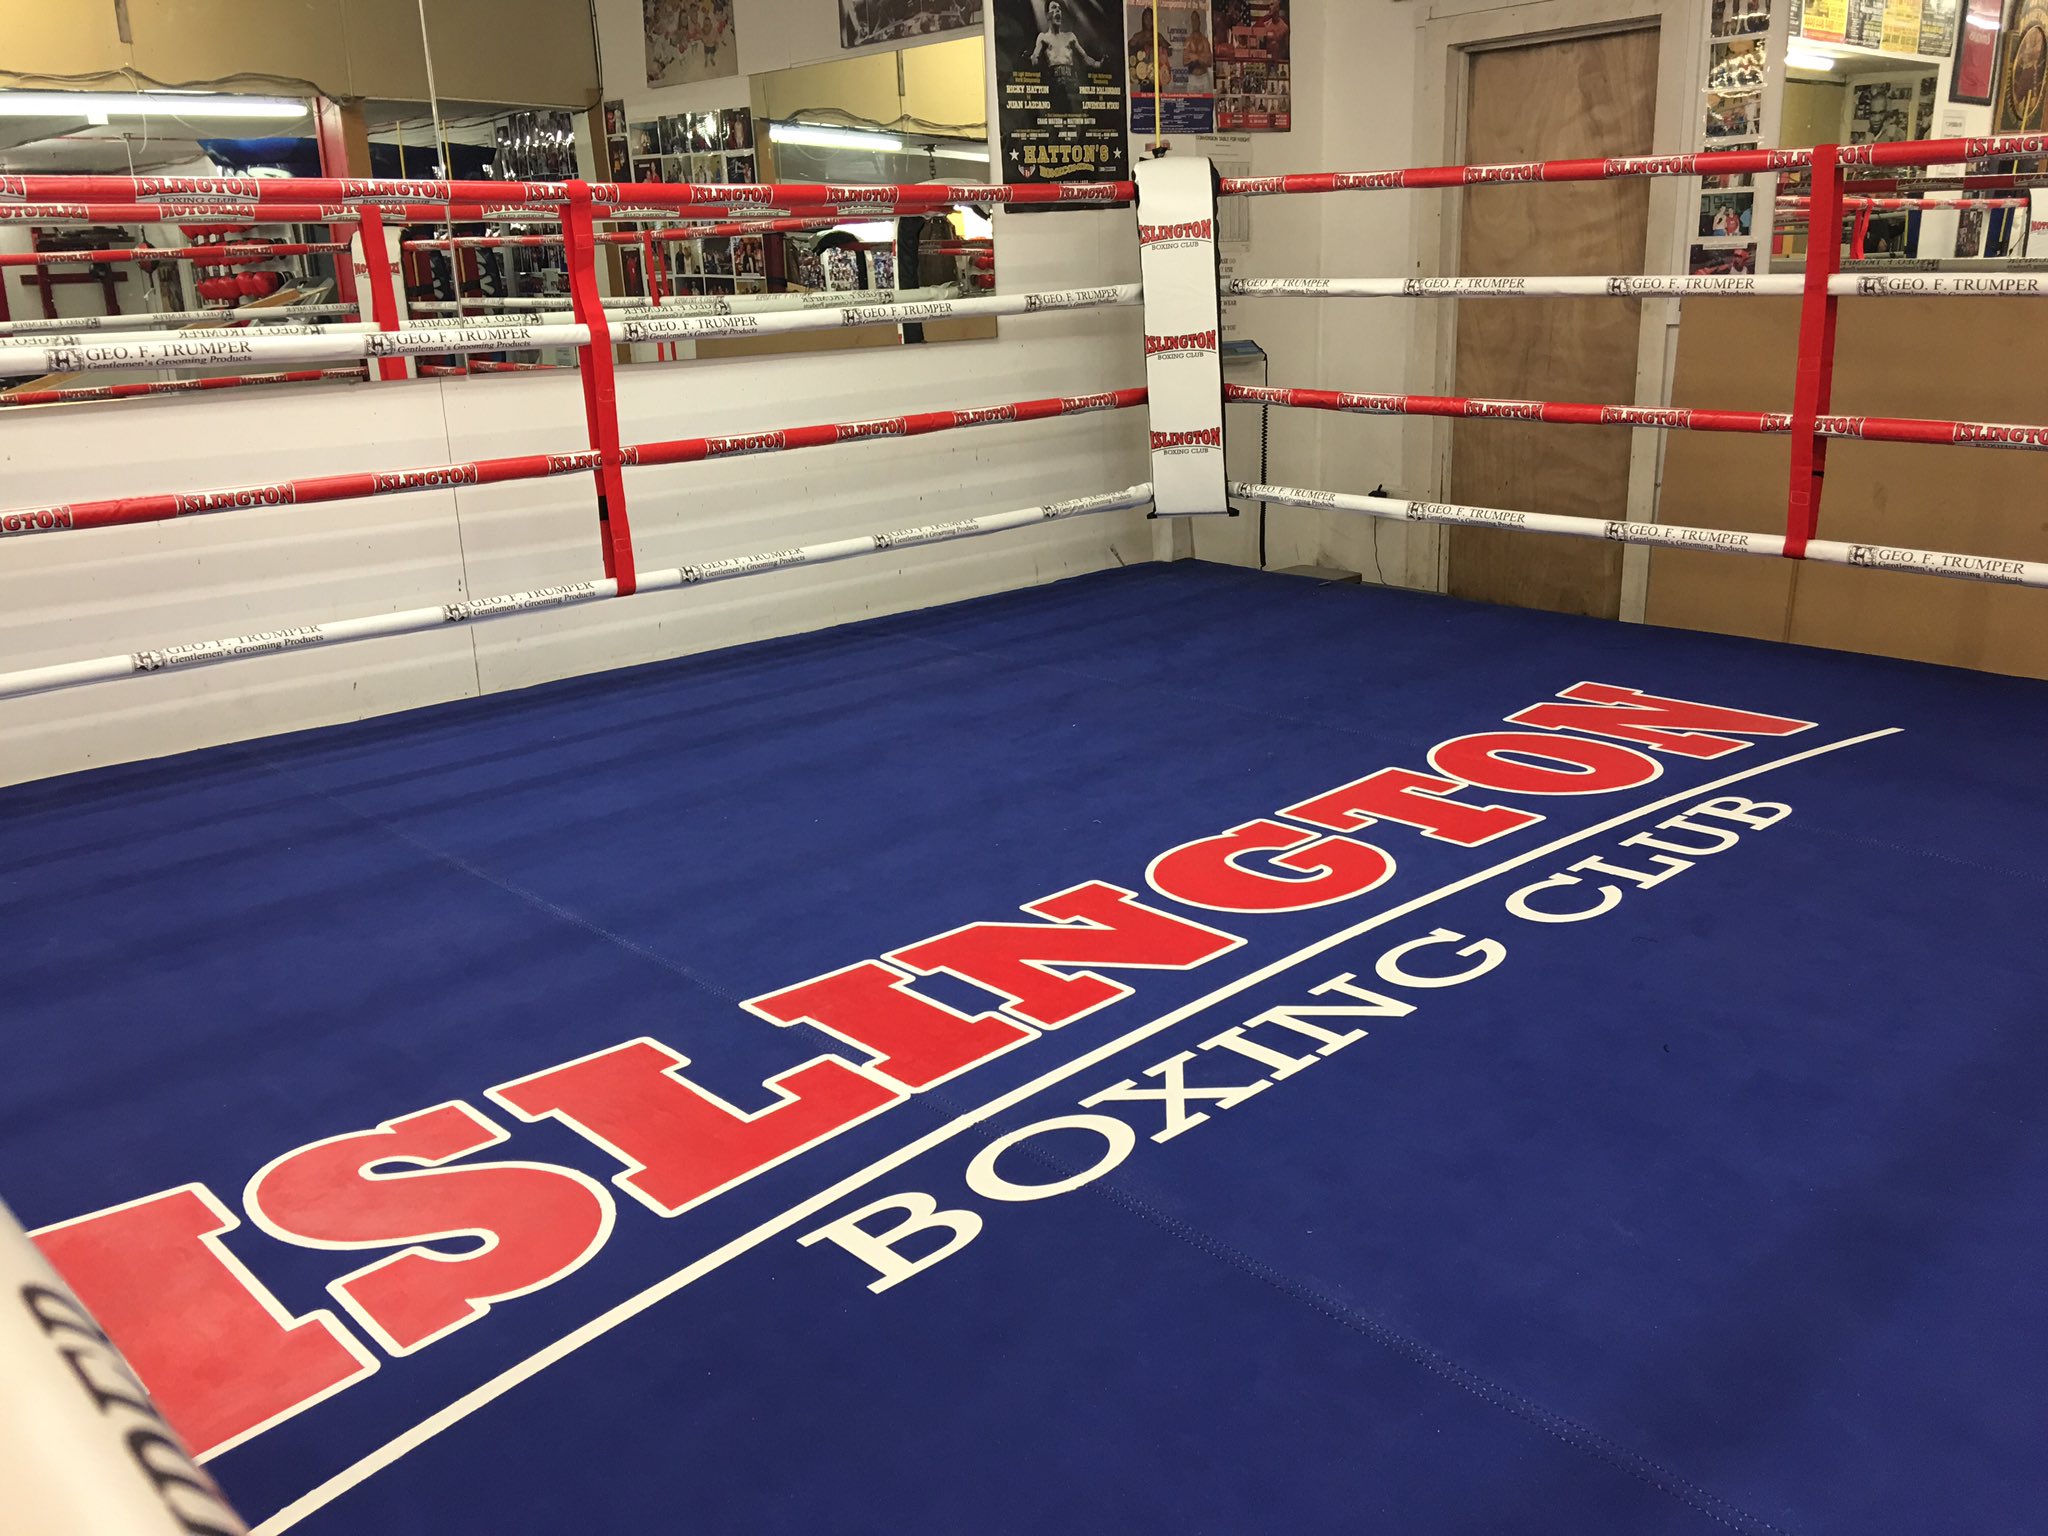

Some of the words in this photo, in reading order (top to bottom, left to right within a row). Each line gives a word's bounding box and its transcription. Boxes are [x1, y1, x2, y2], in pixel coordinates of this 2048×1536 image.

[1023, 144, 1109, 164] HATTON'S
[1769, 145, 1871, 169] ISLINTON
[1966, 136, 2048, 158] ISLINGT
[1465, 164, 1544, 183] ISLINGTON
[1604, 155, 1696, 176] ISLINGTON
[137, 177, 259, 197] ISLINGTON
[343, 180, 449, 200] ISLINGTON
[1222, 178, 1284, 194] ISLINGTON
[1335, 172, 1402, 188] ISLINGTON
[526, 184, 618, 203] ISLINON
[692, 186, 772, 204] ISLINGTON
[826, 187, 898, 204] ISLINGTON
[949, 188, 1012, 202] ISLINGTON
[1060, 185, 1117, 200] ISLINGTON
[1138, 218, 1212, 245] ISLINGTON
[1424, 278, 1450, 288] GEO.
[1454, 278, 1463, 288] F.
[1468, 278, 1525, 288] TRUMPER
[1632, 278, 1664, 290] GEO.
[1668, 278, 1680, 290] F.
[1685, 278, 1754, 290] TRUMPER
[1888, 278, 1928, 291] GEO.
[1934, 278, 1947, 291] F.
[1953, 278, 2039, 292] TRUMPER
[1075, 288, 1118, 301] TRUMPER
[864, 308, 888, 319] GEO.
[892, 308, 900, 316] F.
[902, 303, 953, 315] TRUMPER
[649, 322, 680, 332] GEO.
[683, 321, 694, 330] F.
[694, 316, 758, 329] TRUMPER
[396, 333, 436, 345] GEO.
[440, 332, 452, 343] F.
[454, 328, 532, 342] TRUMPER
[453, 342, 494, 350] Grooming
[1145, 329, 1216, 354] ISLINGTON
[86, 346, 134, 362] GEO.
[139, 345, 156, 358] F.
[159, 341, 252, 356] TRUMPER
[156, 356, 208, 366] Grooming
[210, 354, 252, 364] Products
[1158, 352, 1184, 360] BOXING
[1062, 392, 1118, 412] ISLINGTON
[1229, 385, 1292, 406] ISLINGTON
[1338, 393, 1408, 413] ISLINGTON
[956, 405, 1016, 426] ISLINGTON
[1465, 400, 1542, 420] ISLINGTON
[1602, 407, 1691, 428] ISLINGTON
[836, 418, 906, 440] ISLINGTON
[1762, 413, 1864, 435] ISLGTON
[1954, 423, 2048, 445] ISLINGTO
[708, 432, 785, 455] ISLINGTON
[1150, 427, 1220, 450] ISLINGTON
[548, 448, 637, 474] ISLINGON
[374, 464, 477, 493] ISLINGTON
[177, 484, 294, 514] ISLINGTON
[1428, 504, 1453, 515] GEO.
[1456, 507, 1465, 517] F.
[1470, 508, 1526, 523] TRUMPER
[1629, 524, 1660, 537] GEO.
[1664, 528, 1676, 539] F.
[1680, 529, 1749, 546] TRUMPER
[746, 560, 778, 571] Grooming
[780, 555, 806, 564] Products
[1878, 550, 1917, 564] GEO.
[1922, 553, 1936, 566] F.
[1942, 555, 2024, 574] TRUMPER
[1935, 566, 1981, 579] Grooming
[1983, 572, 2024, 583] Products
[473, 601, 524, 616] Gentlemen's
[524, 596, 562, 608] Grooming
[564, 590, 596, 602] Products
[170, 648, 232, 664] Gentlemen's
[234, 639, 282, 654] Grooming
[284, 633, 324, 647] Products
[797, 927, 1507, 1296] BOXING
[1505, 794, 1793, 924] CLUB
[25, 680, 1818, 1467] ISLINGTON
